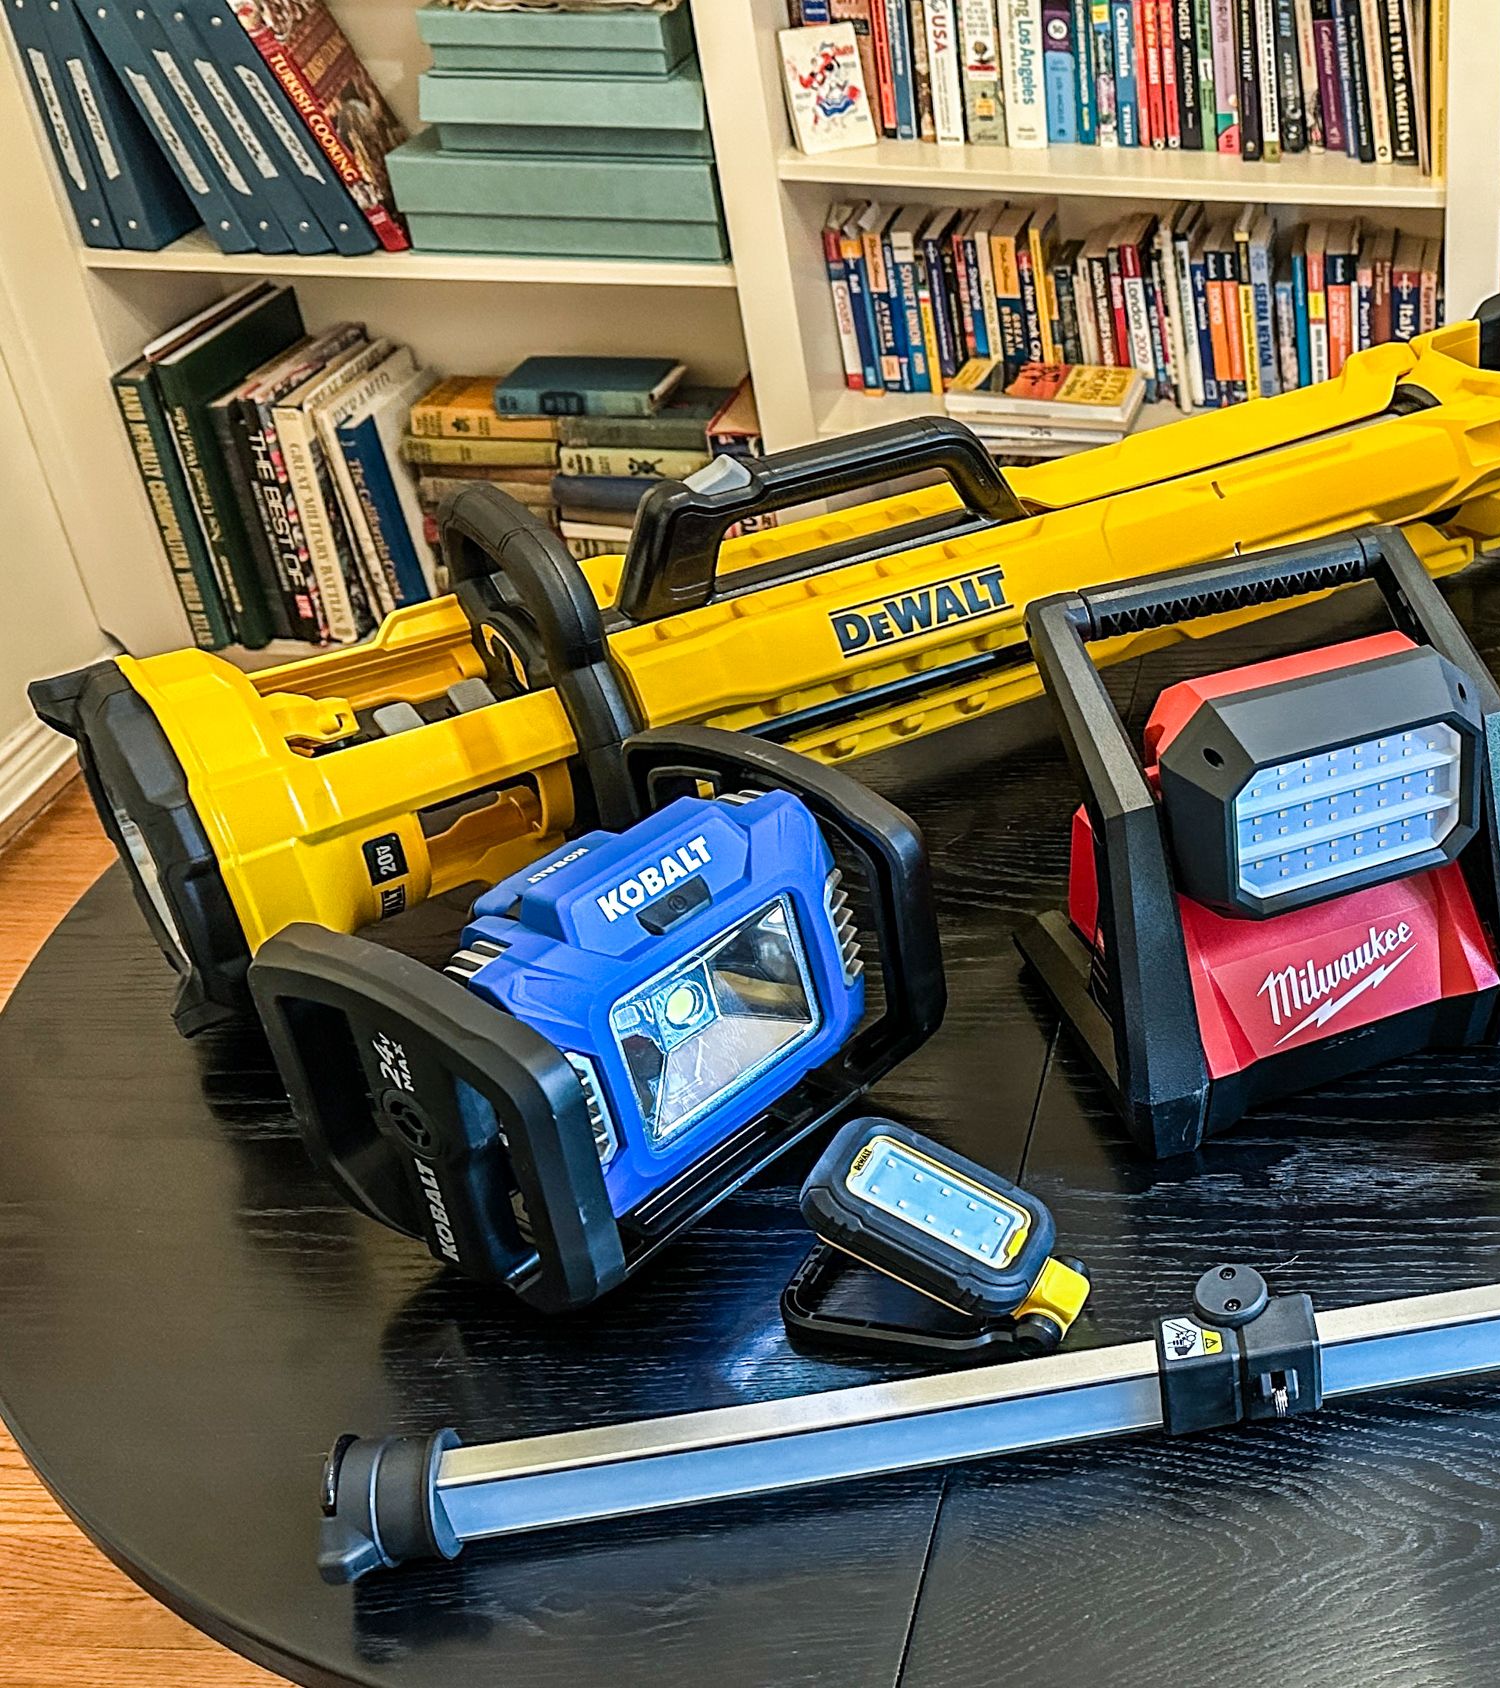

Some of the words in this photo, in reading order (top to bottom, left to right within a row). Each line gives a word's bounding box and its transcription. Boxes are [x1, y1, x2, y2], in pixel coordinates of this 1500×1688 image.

[932, 15, 949, 53] USA
[1018, 20, 1034, 44] Los
[1115, 7, 1130, 78] California
[1018, 47, 1036, 105] Angeles
[1391, 54, 1405, 80] LOS
[269, 53, 312, 114] TURKISH
[308, 109, 358, 183] COOKING
[1393, 83, 1411, 141] ANGELES
[900, 264, 917, 307] SOVIET
[968, 267, 981, 310] Shanghai
[1024, 285, 1036, 311] New
[1254, 283, 1269, 321] SIERRA
[880, 301, 895, 348] ATHENS
[907, 309, 922, 346] UNION
[1002, 306, 1015, 356] BRITAIN
[1011, 313, 1024, 348] GREAT
[1028, 314, 1040, 338] York
[1127, 281, 1143, 331] London
[1135, 334, 1150, 364] 2009
[1359, 302, 1371, 337] Puerto
[1394, 304, 1414, 340] Italy
[1258, 325, 1273, 368] NEVADA
[249, 431, 276, 485] THE
[264, 485, 294, 549] BEST
[286, 552, 308, 588] OF
[289, 442, 311, 497] GREAT
[302, 497, 330, 564] MILITARY
[527, 847, 590, 884] KOBALT
[597, 835, 713, 923] KOBALT
[1257, 921, 1414, 1026] Milwaukee
[414, 1158, 461, 1264] KOBALT
